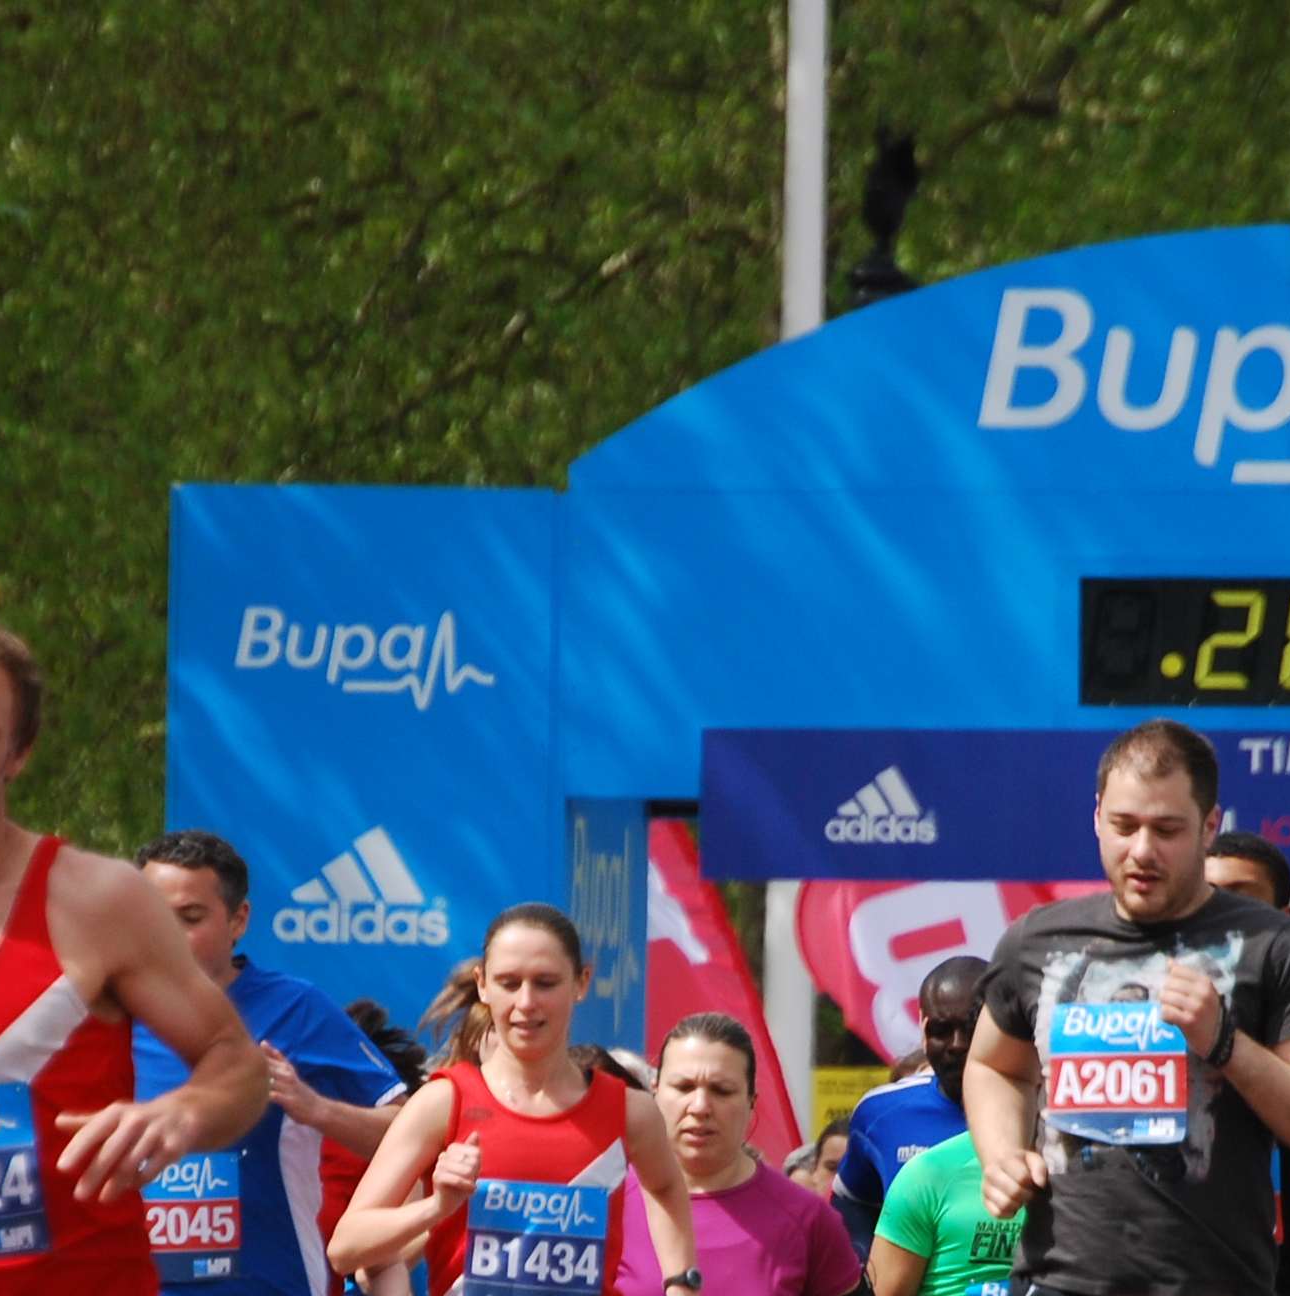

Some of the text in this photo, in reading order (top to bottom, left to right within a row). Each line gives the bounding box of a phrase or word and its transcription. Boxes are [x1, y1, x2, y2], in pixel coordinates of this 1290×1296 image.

[234, 605, 427, 693] Bupa
[824, 814, 938, 845] adidas
[272, 900, 449, 947] adidas
[1062, 1006, 1146, 1045] Bupa
[1053, 1058, 1178, 1105] A2061
[483, 1184, 568, 1224] Bupa
[471, 1234, 600, 1286] B1434
